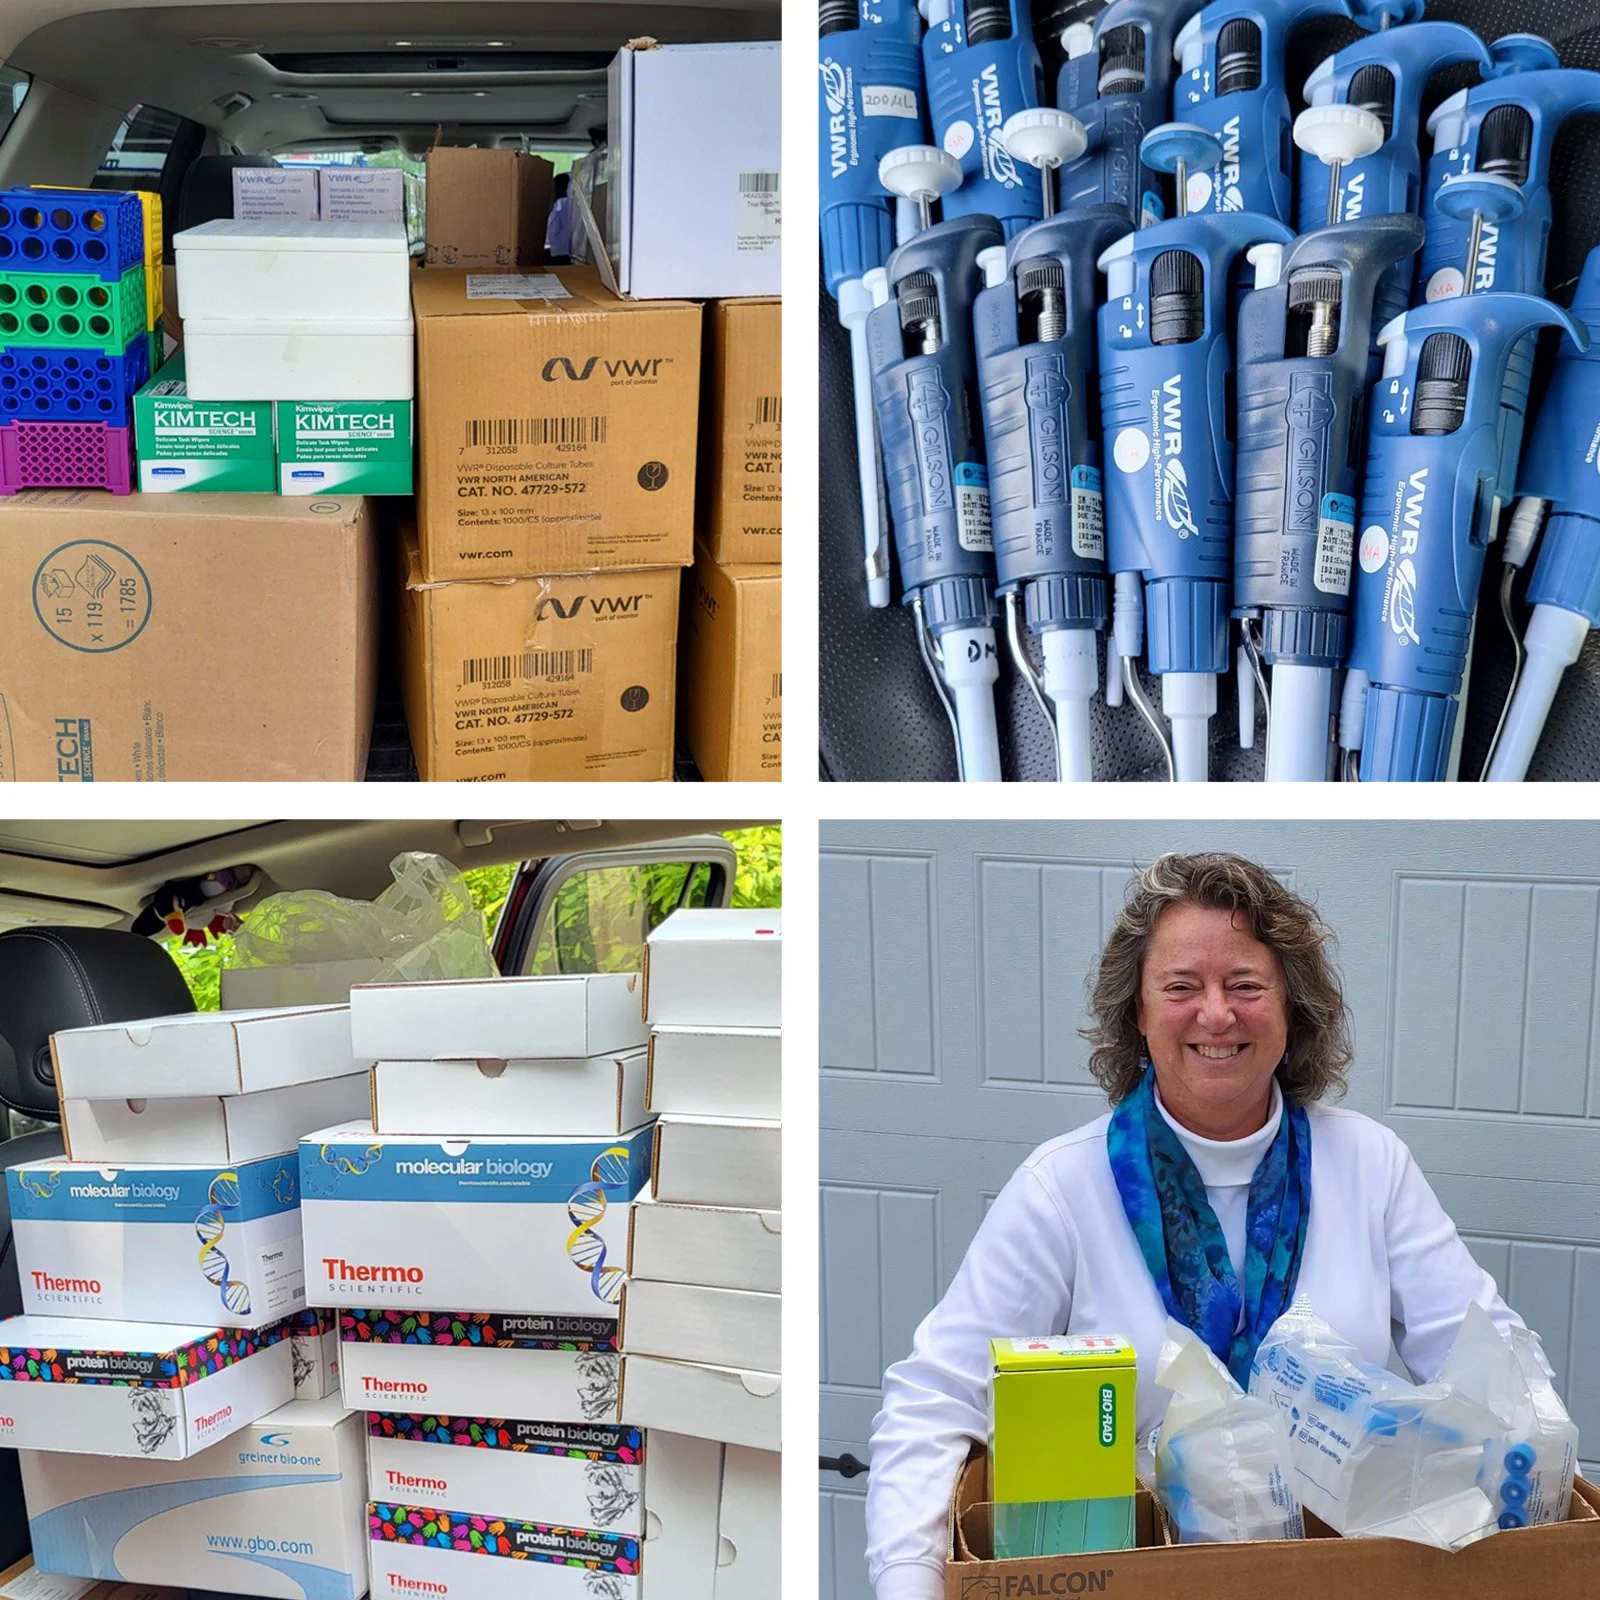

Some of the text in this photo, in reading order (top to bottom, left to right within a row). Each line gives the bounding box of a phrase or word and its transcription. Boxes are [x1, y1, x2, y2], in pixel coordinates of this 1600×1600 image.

[981, 63, 1002, 128] VWR
[830, 114, 848, 179] VWR
[1223, 115, 1240, 187] VWR
[239, 176, 264, 184] VWR
[154, 402, 193, 410] Kimwipes
[295, 405, 334, 414] Kimwipes
[1163, 374, 1182, 456] VWR
[154, 410, 256, 427] KIMTECH
[296, 414, 394, 430] KIMTECH
[459, 444, 587, 455] 7 312058 429164
[745, 452, 768, 460] VWR
[1040, 416, 1062, 500] GILSON
[1150, 389, 1162, 521] Ergonomic High-Performance
[486, 462, 534, 473] Disposable
[536, 461, 568, 470] Culture
[570, 460, 594, 469] Tubes
[744, 462, 774, 473] CAT.
[923, 427, 946, 512] GILSON
[457, 473, 570, 484] VWR NORTH AMERICAN
[1293, 438, 1318, 530] GILSON
[458, 483, 586, 498] CAT. NO. 47729-572
[744, 484, 764, 492] Size:
[458, 508, 478, 518] Size:
[481, 508, 490, 516] 13
[499, 507, 514, 516] 100
[516, 507, 534, 515] mm
[1400, 468, 1428, 555] VWR
[458, 518, 501, 526] Contents:
[502, 516, 540, 526] 1000/CS
[459, 550, 513, 560] vwr.com
[1381, 480, 1406, 622] Ergonomic High-Performance
[120, 578, 136, 614] 1785
[56, 607, 72, 625] 15
[87, 602, 104, 628] 119
[482, 680, 511, 690] 312058
[545, 674, 574, 684] 429164
[482, 693, 526, 705] Disposable
[527, 690, 556, 701] Culture
[558, 688, 580, 698] Tubes
[143, 700, 152, 720] Blanc
[455, 701, 558, 718] VWR NORTH AMERICAN
[155, 712, 164, 738] Blanco
[455, 708, 574, 730] CAT. NO. 47729-572
[455, 738, 474, 748] Size:
[476, 737, 485, 746] 13
[494, 735, 508, 744] 100
[455, 734, 588, 756] Contents: 1000/CS (approximate)
[82, 744, 92, 778] SCIENCE
[396, 1158, 553, 1178] molecular biology
[70, 1184, 180, 1200] molecular biology
[262, 1250, 284, 1262] Thermo
[322, 1258, 424, 1283] Thermo
[31, 1272, 101, 1294] Thermo
[328, 1283, 423, 1294] SCIENTIFIC
[37, 1294, 102, 1305] SCIENTIFIC
[502, 1316, 612, 1335] protein biology
[66, 1356, 154, 1374] protein biology
[361, 1376, 428, 1394] Thermo
[366, 1393, 427, 1402] SCIENTIFIC
[194, 1405, 232, 1432] Thermo
[1102, 1388, 1113, 1443] BIO-RAD
[197, 1418, 232, 1440] SCIENTIFIC
[517, 1423, 619, 1447] protein biology
[239, 1452, 322, 1466] greiner bio-one
[386, 1470, 447, 1490] Thermo
[390, 1486, 447, 1498] SCIENTIFIC
[206, 1534, 314, 1556] www.gbo.com
[516, 1530, 618, 1557] protein biology
[387, 1574, 448, 1594] Thermo
